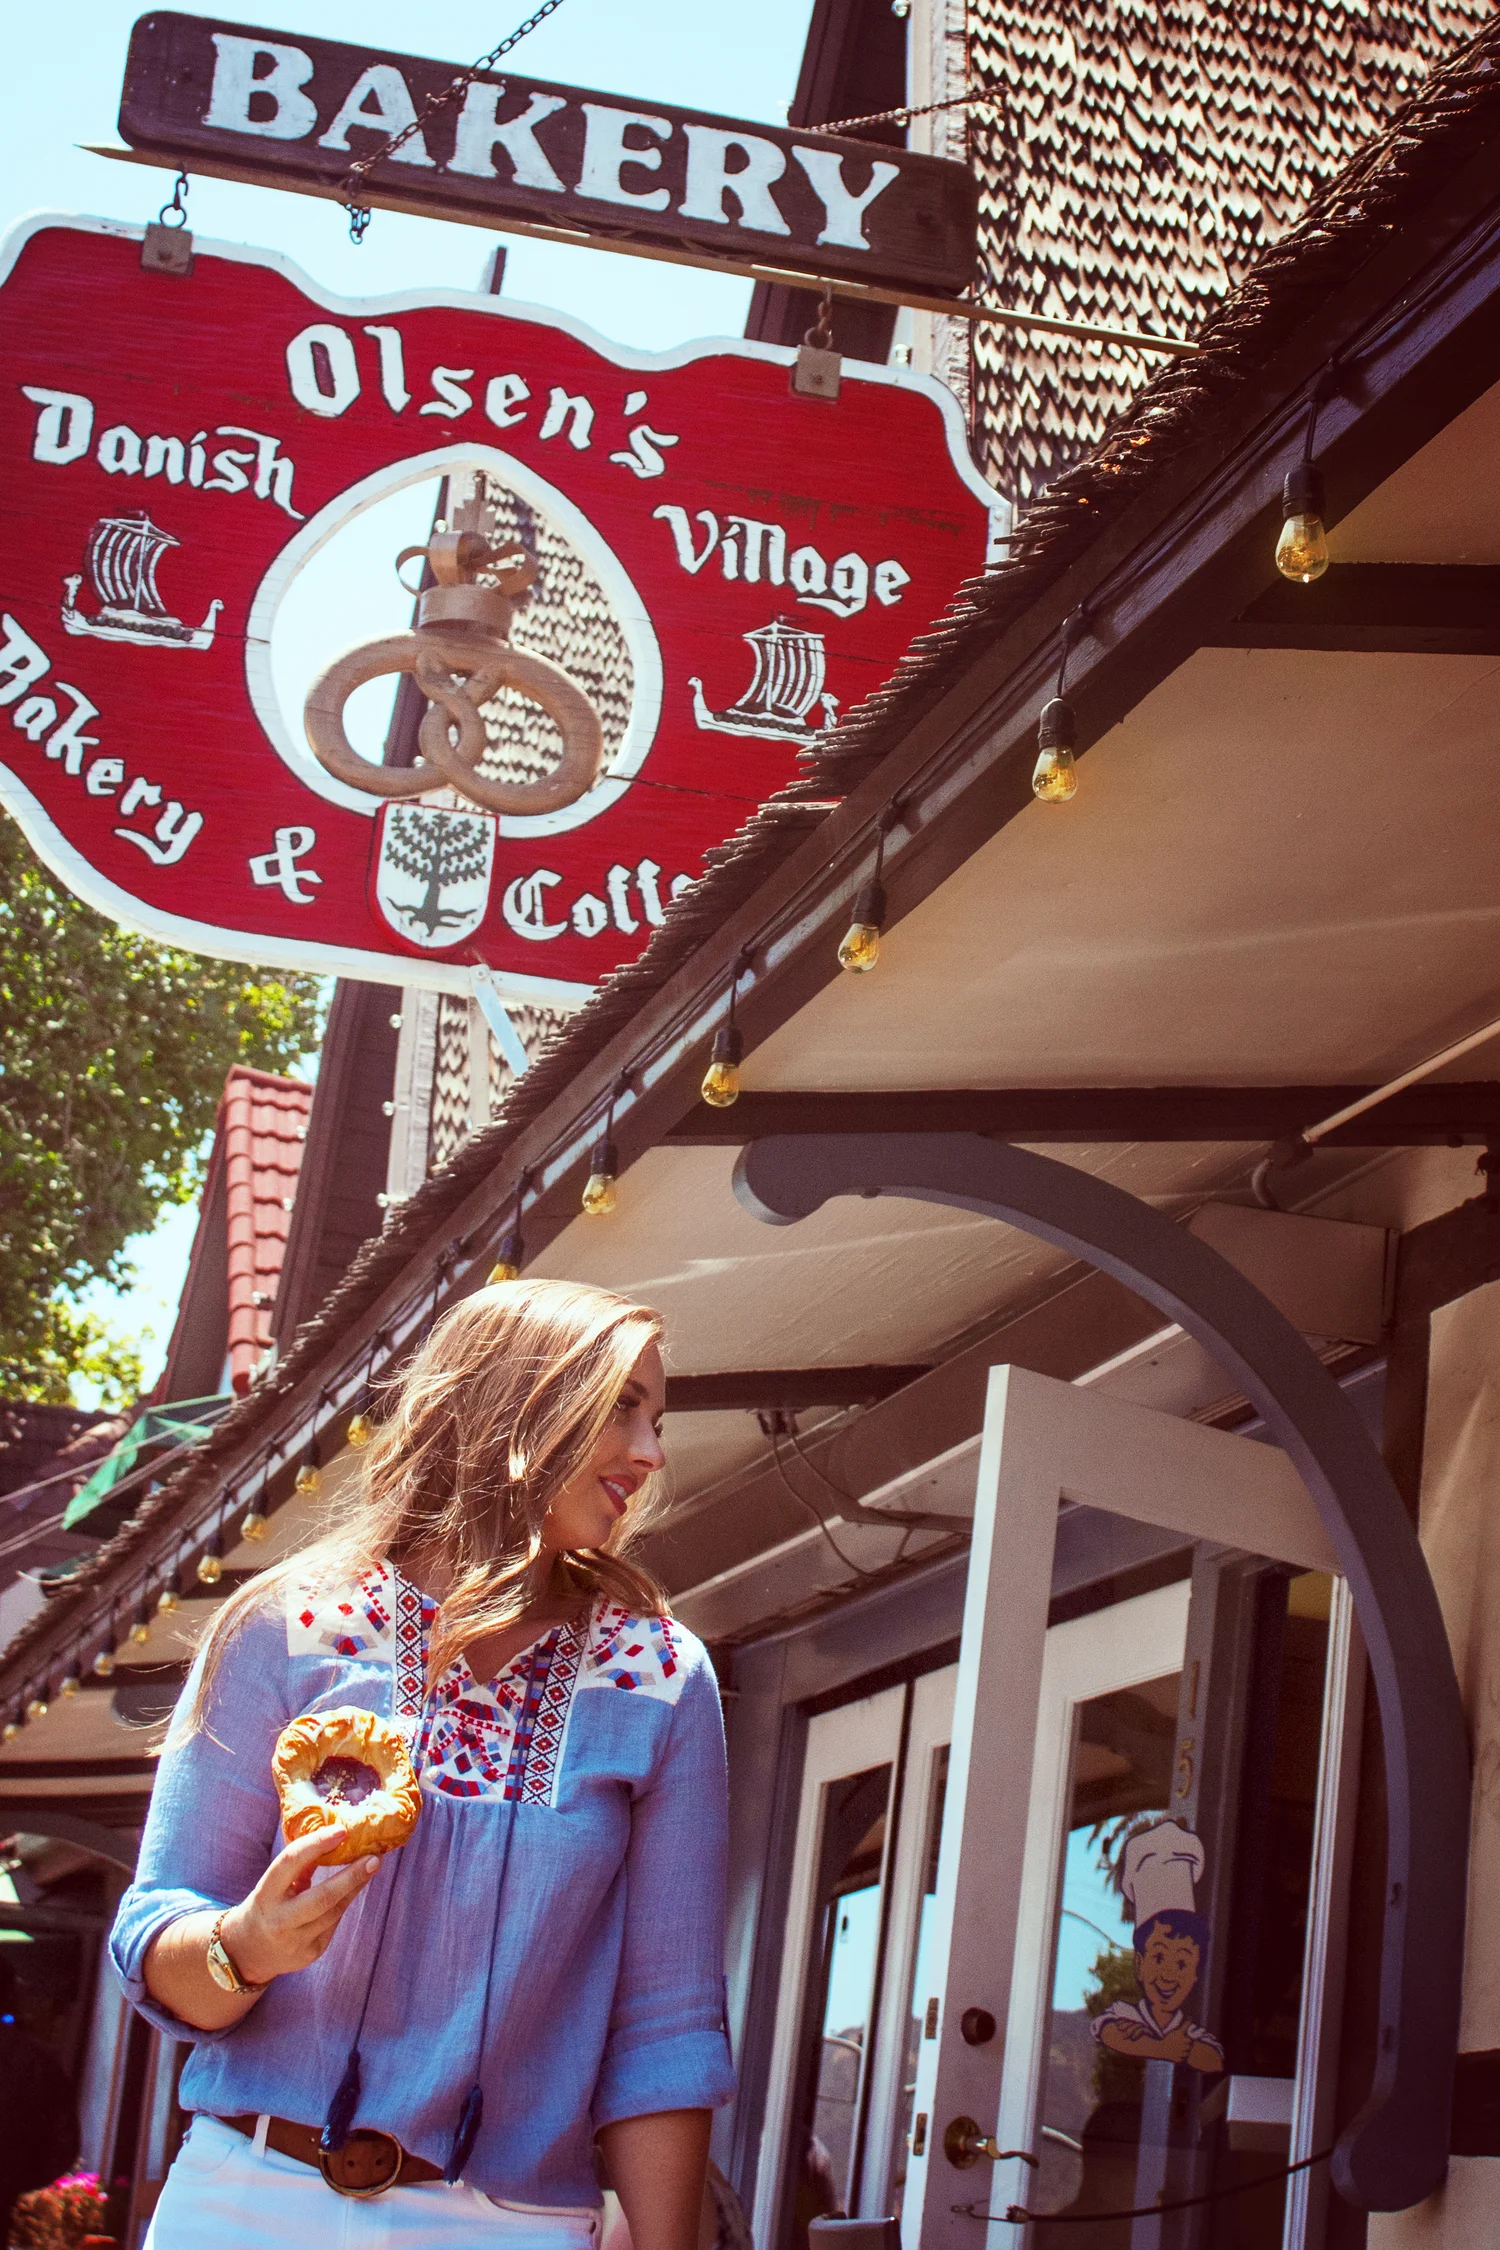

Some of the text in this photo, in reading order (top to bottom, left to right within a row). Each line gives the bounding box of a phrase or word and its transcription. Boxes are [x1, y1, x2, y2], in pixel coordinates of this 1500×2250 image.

[201, 33, 901, 250] BAKERY
[20, 385, 911, 619] Danish Village
[285, 324, 679, 479] Olsen's
[0, 613, 204, 866] Bakery
[249, 826, 323, 904] &
[1175, 1660, 1200, 1828] 15
